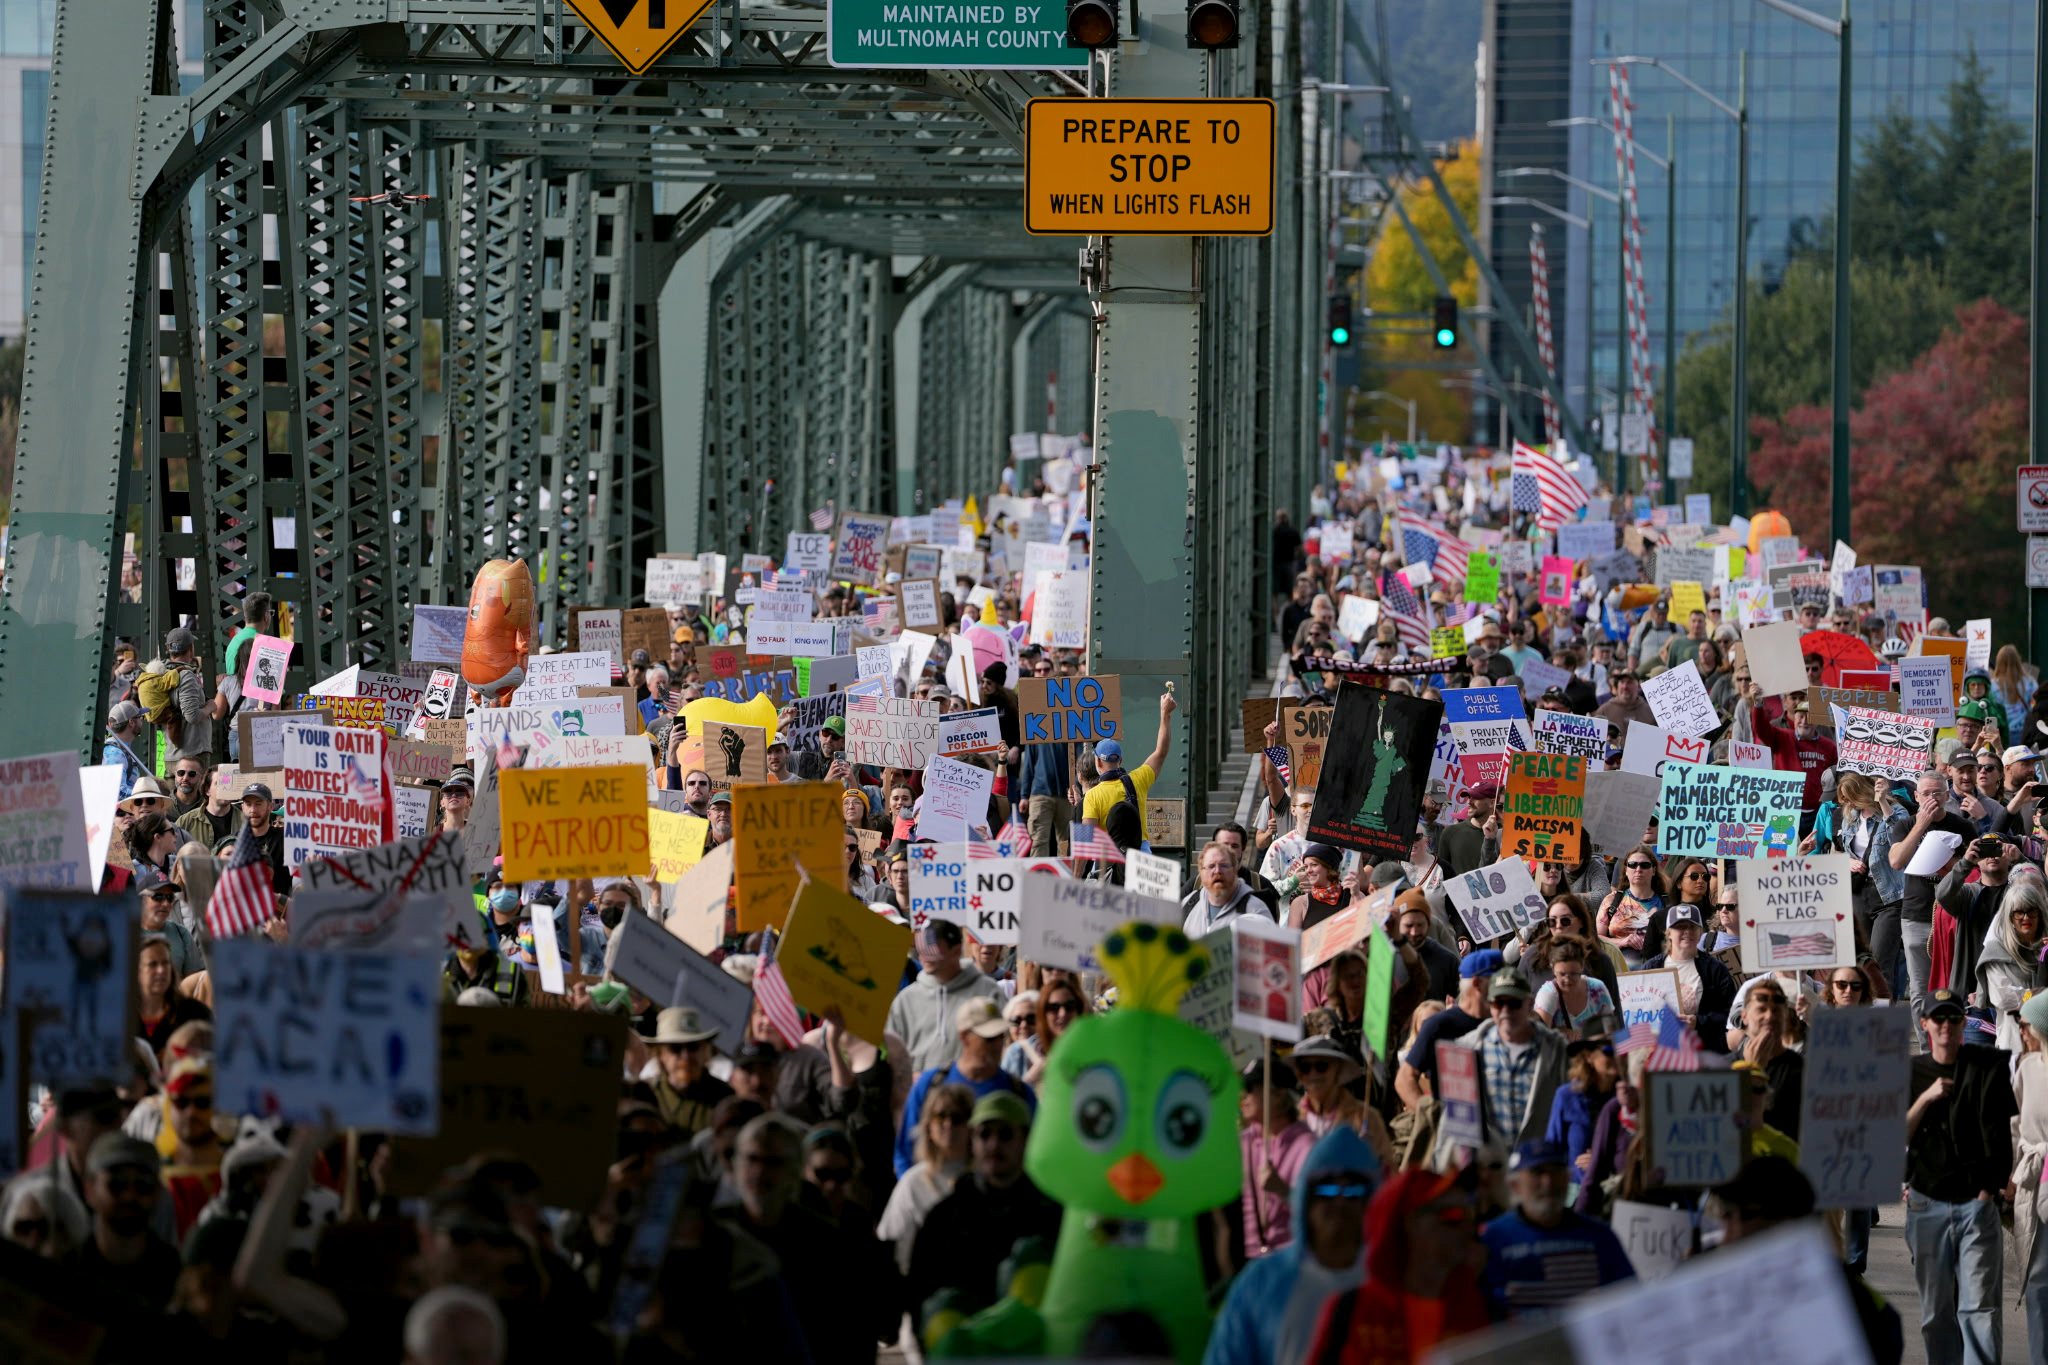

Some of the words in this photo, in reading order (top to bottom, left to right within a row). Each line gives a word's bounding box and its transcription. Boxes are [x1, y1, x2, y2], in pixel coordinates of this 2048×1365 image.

[883, 5, 1005, 24] MAINTAINED
[1015, 6, 1041, 24] BY
[857, 29, 979, 48] MULTNOMAH
[986, 30, 1066, 48] COUNTY
[1063, 118, 1191, 144] PREPARE
[1207, 119, 1240, 144] TO
[1109, 154, 1191, 182] STOP
[1050, 194, 1103, 214] WHEN
[1114, 194, 1169, 215] LIGHTS
[1189, 194, 1250, 215] FLASH
[795, 536, 824, 554] ICE
[903, 583, 931, 591] RELEASE
[585, 619, 612, 629] REAL
[580, 630, 620, 641] PATRIOTS
[757, 636, 768, 644] NO
[794, 637, 812, 645] KING
[561, 657, 606, 671] EATING
[714, 656, 735, 670] STOP
[859, 649, 889, 661] SUPER
[1303, 655, 1369, 673] FUCK
[1373, 655, 1459, 674] TRUMP
[431, 672, 455, 687] DON'T
[524, 675, 536, 687] HE
[539, 672, 576, 685] CHECKS
[1655, 670, 1676, 683] THE
[1903, 669, 1946, 678] DEMOCRACY
[1911, 679, 1940, 687] DOESN'T
[357, 681, 424, 705] DEPORT
[703, 668, 796, 703] GRIFT
[1046, 677, 1105, 709] NO
[1647, 674, 1692, 702] AMERICA
[1917, 689, 1936, 697] FEAR
[1464, 694, 1498, 704] PUBLIC
[1656, 701, 1667, 711] I
[1669, 683, 1702, 704] SWORE
[1820, 689, 1888, 705] PEOPLE
[1912, 698, 1942, 707] PROTEST
[581, 702, 622, 715] KINGS!
[878, 697, 938, 718] SCIENCE
[1467, 704, 1501, 715] OFFICE
[1657, 712, 1671, 722] TO
[1672, 693, 1708, 717] PROTECT
[1689, 706, 1711, 722] NO
[1850, 707, 1877, 718] DON'T
[1878, 711, 1906, 723] DON'T
[1906, 717, 1935, 727] DON'T
[1906, 707, 1940, 716] DICTATORS
[427, 722, 439, 730] ALL
[480, 709, 543, 733] HANDS
[847, 718, 882, 738] SAVES
[886, 722, 921, 740] LIVES
[923, 723, 939, 740] OF
[1025, 706, 1116, 741] KING
[1294, 709, 1332, 738] SOR
[1542, 721, 1557, 732] LA
[1560, 724, 1600, 740] MIGRA!
[426, 730, 466, 740] OUTRAGE
[946, 731, 988, 743] OREGON
[1470, 727, 1510, 738] PRIVATE
[1534, 730, 1554, 743] THE
[1556, 734, 1607, 751] CRUELTY
[335, 732, 374, 755] OATH
[565, 740, 590, 760] Not
[948, 741, 968, 751] FOR
[970, 738, 989, 749] ALL
[1473, 737, 1507, 748] PROFIT
[1535, 740, 1546, 751] IS
[1546, 742, 1567, 755] THE
[1734, 743, 1762, 760] UNPAID
[1844, 740, 1871, 751] OBEY
[1871, 744, 1898, 756] OBEY
[1900, 749, 1927, 760] OBEY
[315, 752, 328, 769] IS
[399, 745, 449, 779] Kings
[846, 740, 926, 770] AMERICANS
[1841, 750, 1868, 760] DON'T
[1869, 754, 1897, 765] DON'T
[1897, 759, 1925, 771] DON'T
[933, 756, 963, 775] Purge
[965, 766, 984, 780] The
[1511, 754, 1581, 781] PEACE
[285, 768, 350, 794] PROTECT
[929, 777, 971, 797] Release
[934, 769, 981, 789] Traitors
[1697, 772, 1720, 784] UN
[1730, 774, 1806, 794] PRESIDENTE
[519, 778, 561, 806] WE
[578, 777, 625, 806] ARE
[938, 789, 961, 800] The
[1665, 785, 1760, 806] MAMABICHO
[1770, 794, 1803, 810] QUE
[286, 795, 380, 826] CONSTITUTION
[658, 790, 681, 813] TO
[1504, 792, 1584, 819] LIBERATION
[741, 799, 842, 833] ANTIFA
[1664, 805, 1688, 821] NO
[1741, 806, 1768, 823] UN
[285, 823, 310, 840] AND
[310, 824, 378, 848] CITIZENS
[859, 830, 876, 839] WILL
[1514, 816, 1575, 836] RACISM
[1717, 822, 1746, 839] BAD
[511, 813, 649, 860] PATRIOTS
[667, 837, 686, 855] ME
[293, 847, 310, 863] OF
[1716, 839, 1759, 859] BUNNY
[1780, 859, 1804, 873] MY
[977, 873, 1014, 892] NO
[1758, 877, 1782, 890] NO
[1787, 873, 1838, 890] KINGS
[1766, 890, 1823, 906] ANTIFA
[1776, 906, 1817, 921] FLAG
[218, 951, 394, 1017] SAVE
[1635, 985, 1645, 993] AS
[1665, 1081, 1675, 1113] I
[1688, 1081, 1729, 1113] AM
[1666, 1116, 1722, 1146] AINT
[1668, 1151, 1727, 1181] TIFA
[1629, 1214, 1686, 1258] Fuck
